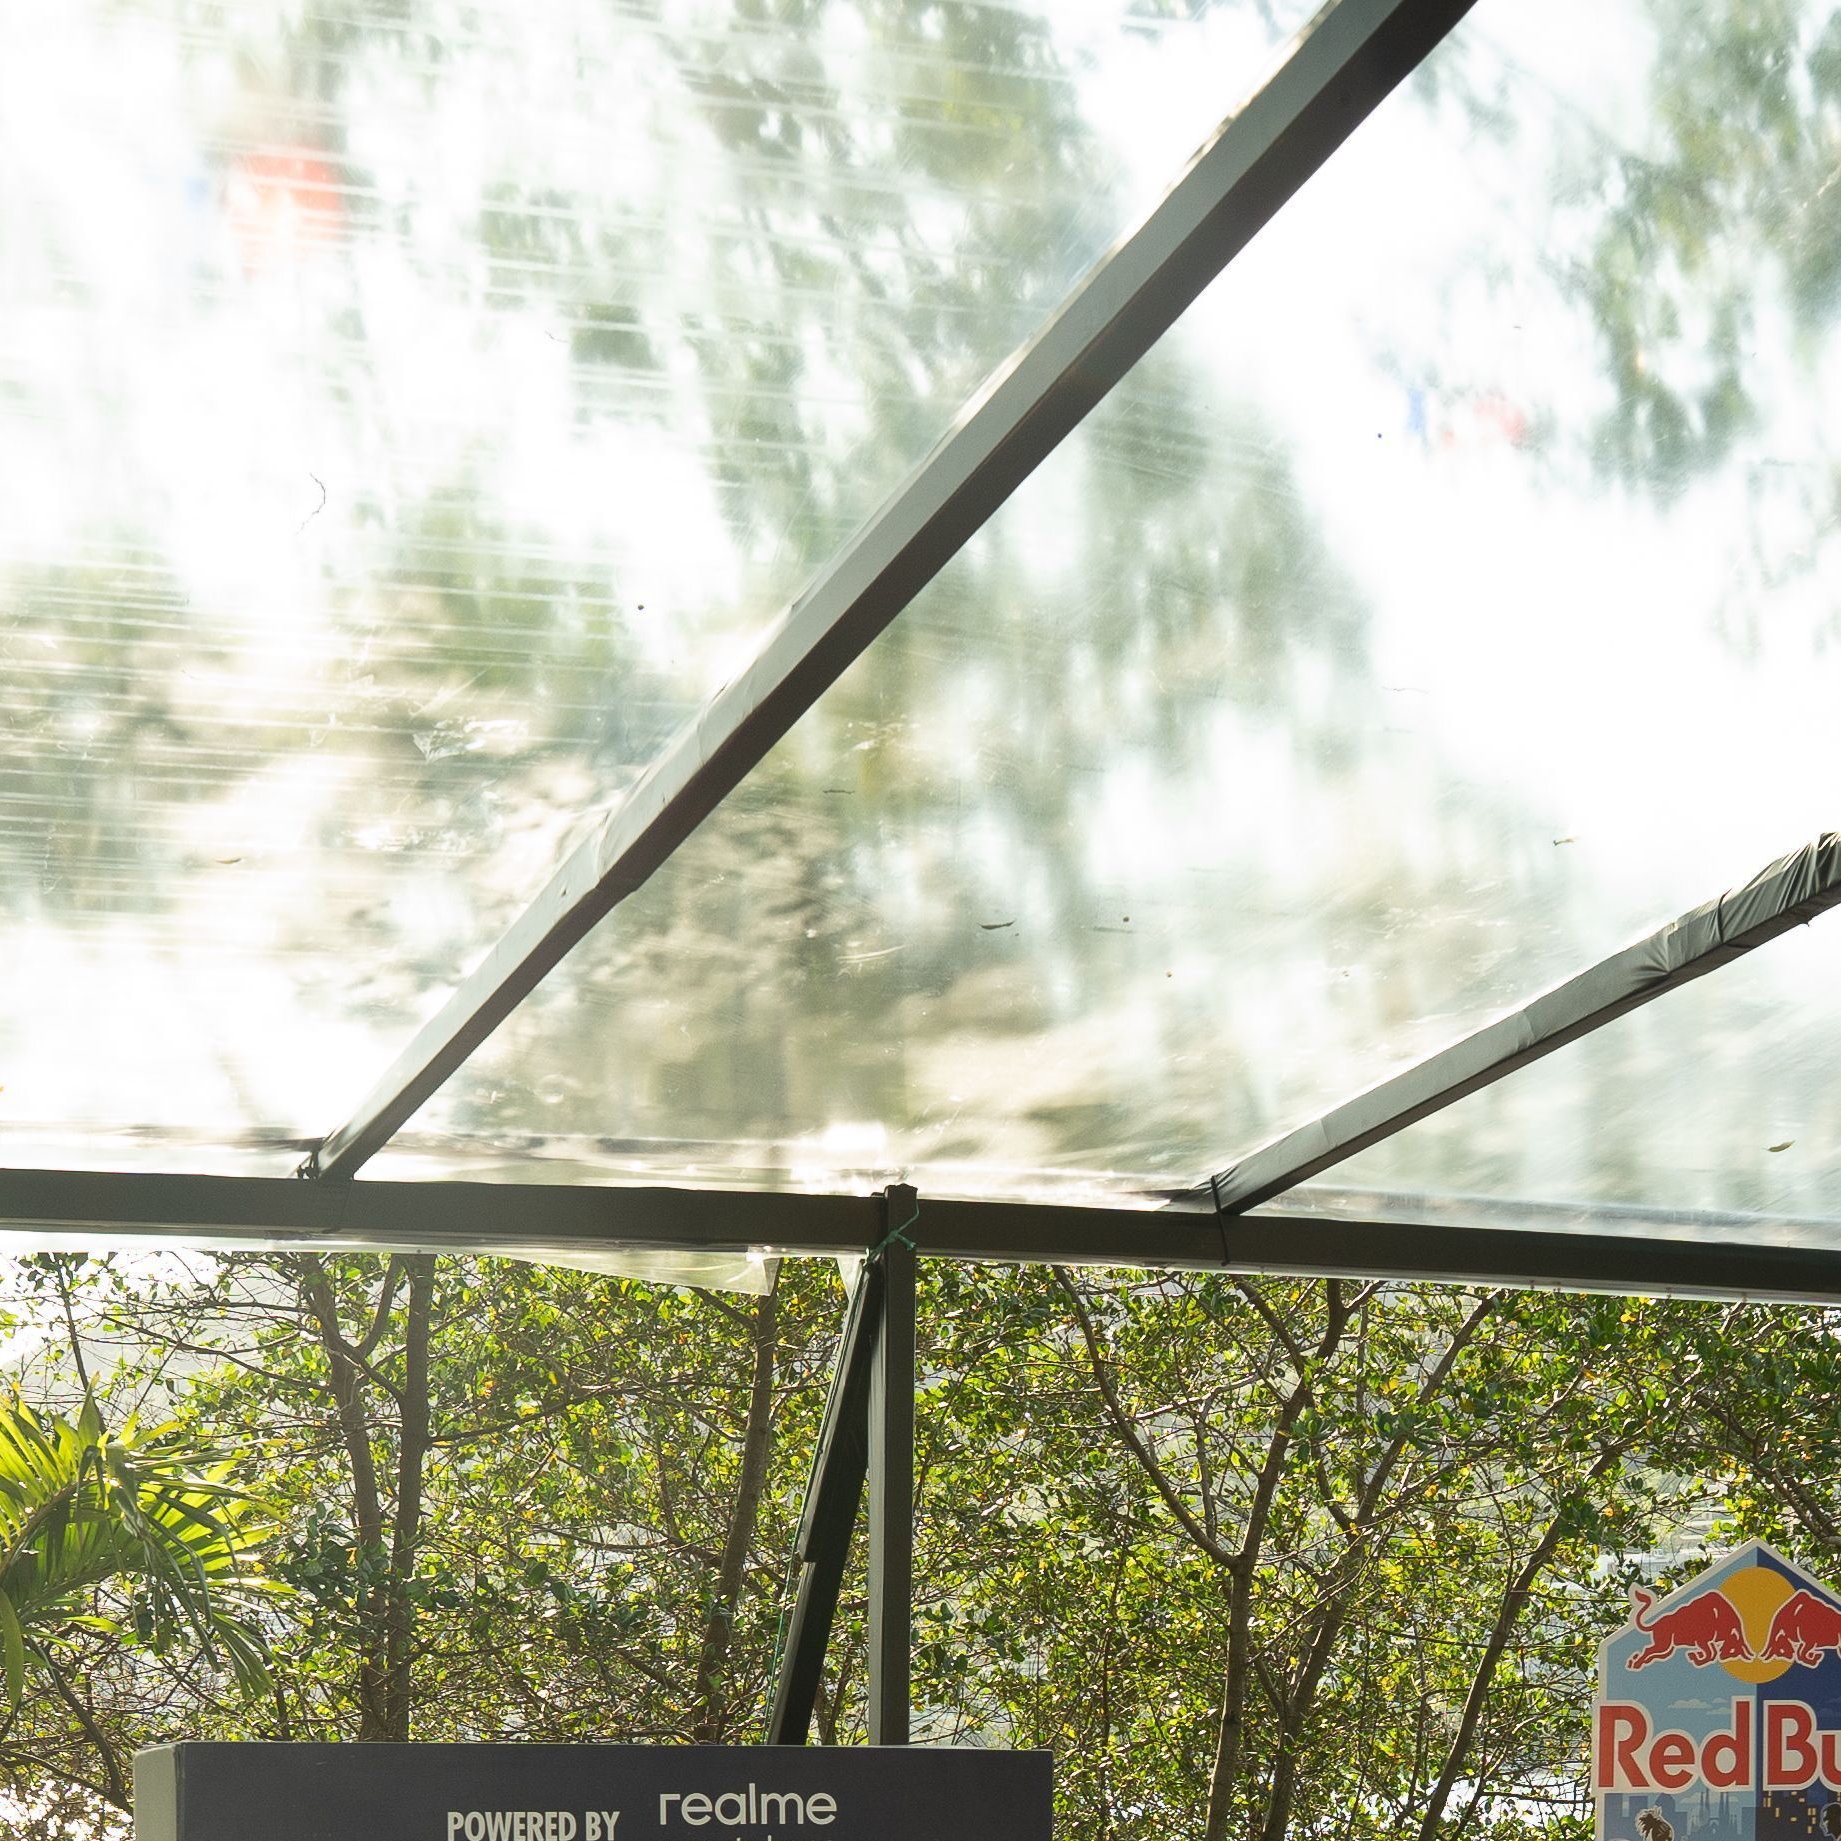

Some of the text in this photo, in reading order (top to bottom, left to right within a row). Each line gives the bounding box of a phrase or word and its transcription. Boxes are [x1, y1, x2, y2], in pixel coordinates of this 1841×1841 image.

[1598, 1701, 1751, 1789] Red
[660, 1783, 837, 1825] realme
[447, 1811, 619, 1841] POWERED BY
